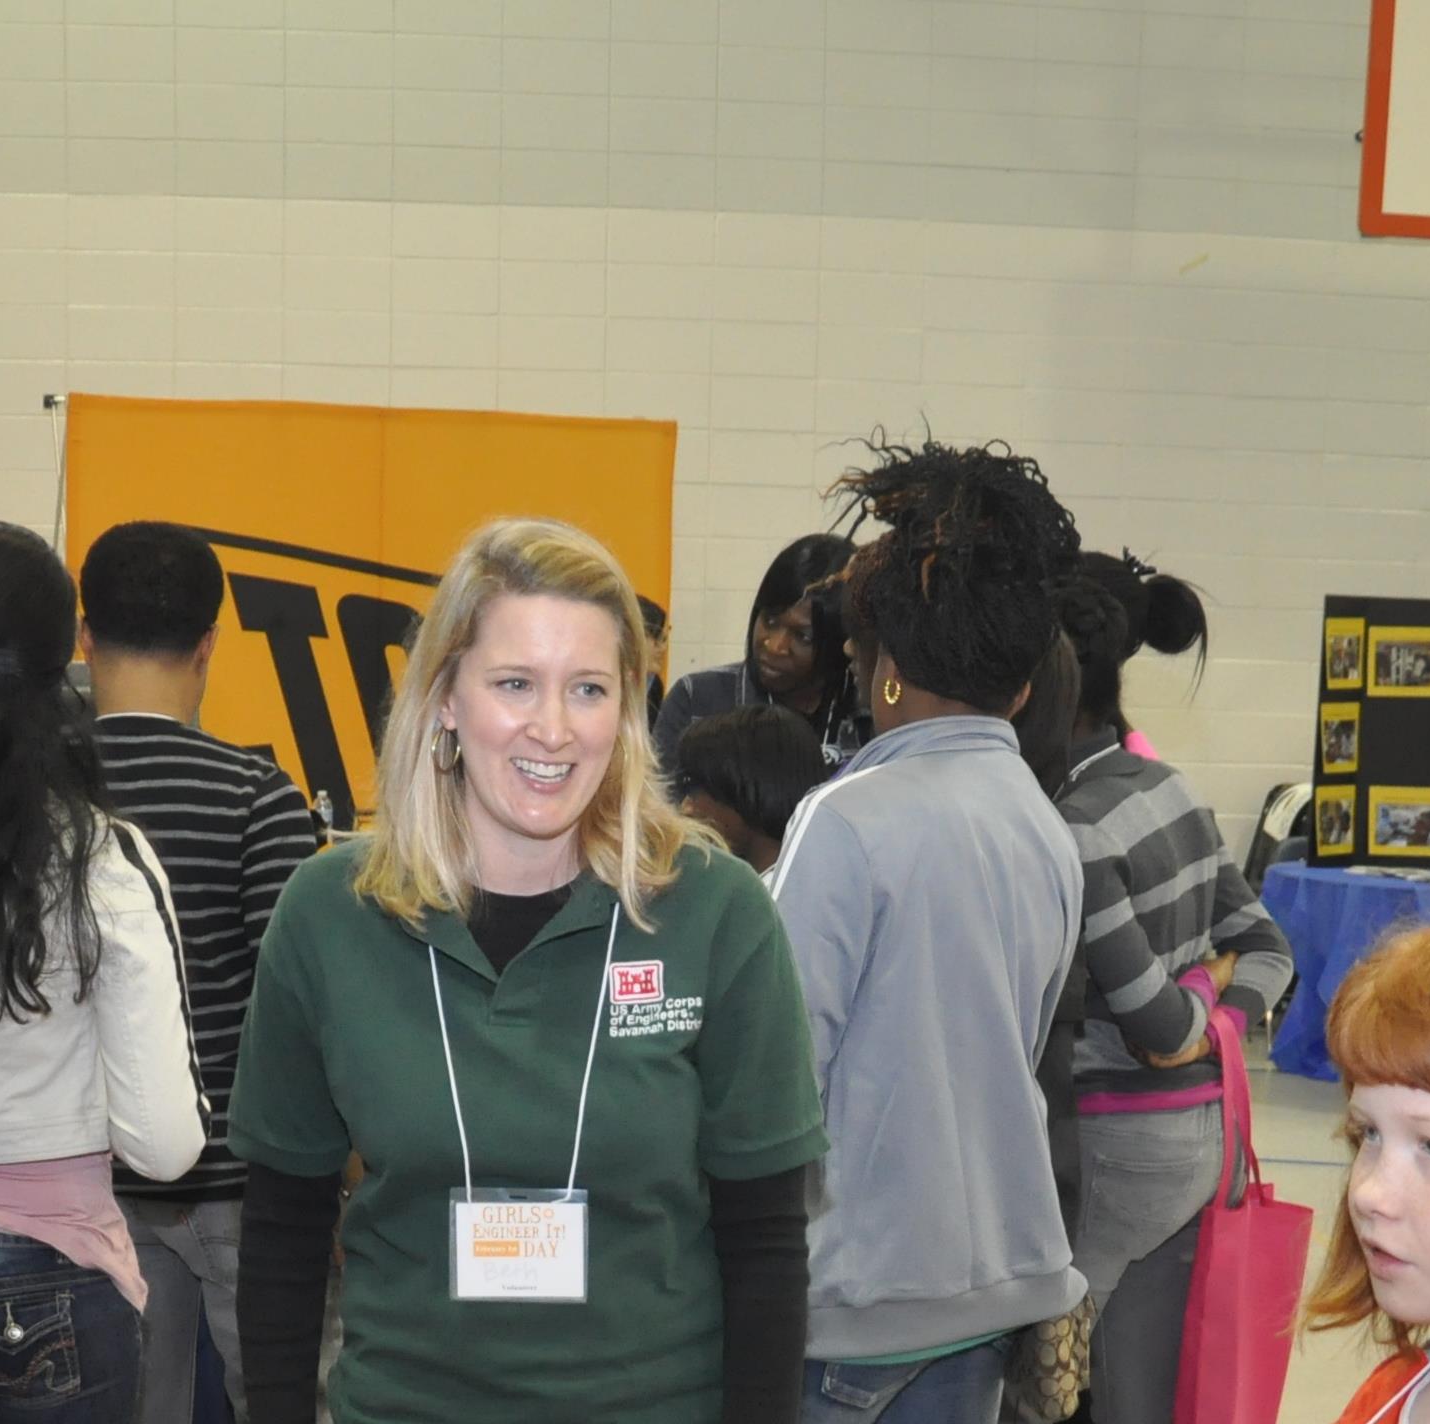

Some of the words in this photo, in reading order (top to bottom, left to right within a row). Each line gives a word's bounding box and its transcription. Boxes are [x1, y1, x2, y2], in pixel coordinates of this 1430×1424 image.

[610, 1004, 628, 1016] US
[632, 1003, 663, 1018] Army
[665, 997, 703, 1009] Corps
[609, 1022, 664, 1037] Savannah
[667, 1018, 703, 1031] Distri
[610, 1014, 624, 1026] of
[483, 1206, 541, 1224] GIRLS
[524, 1241, 559, 1257] DAY
